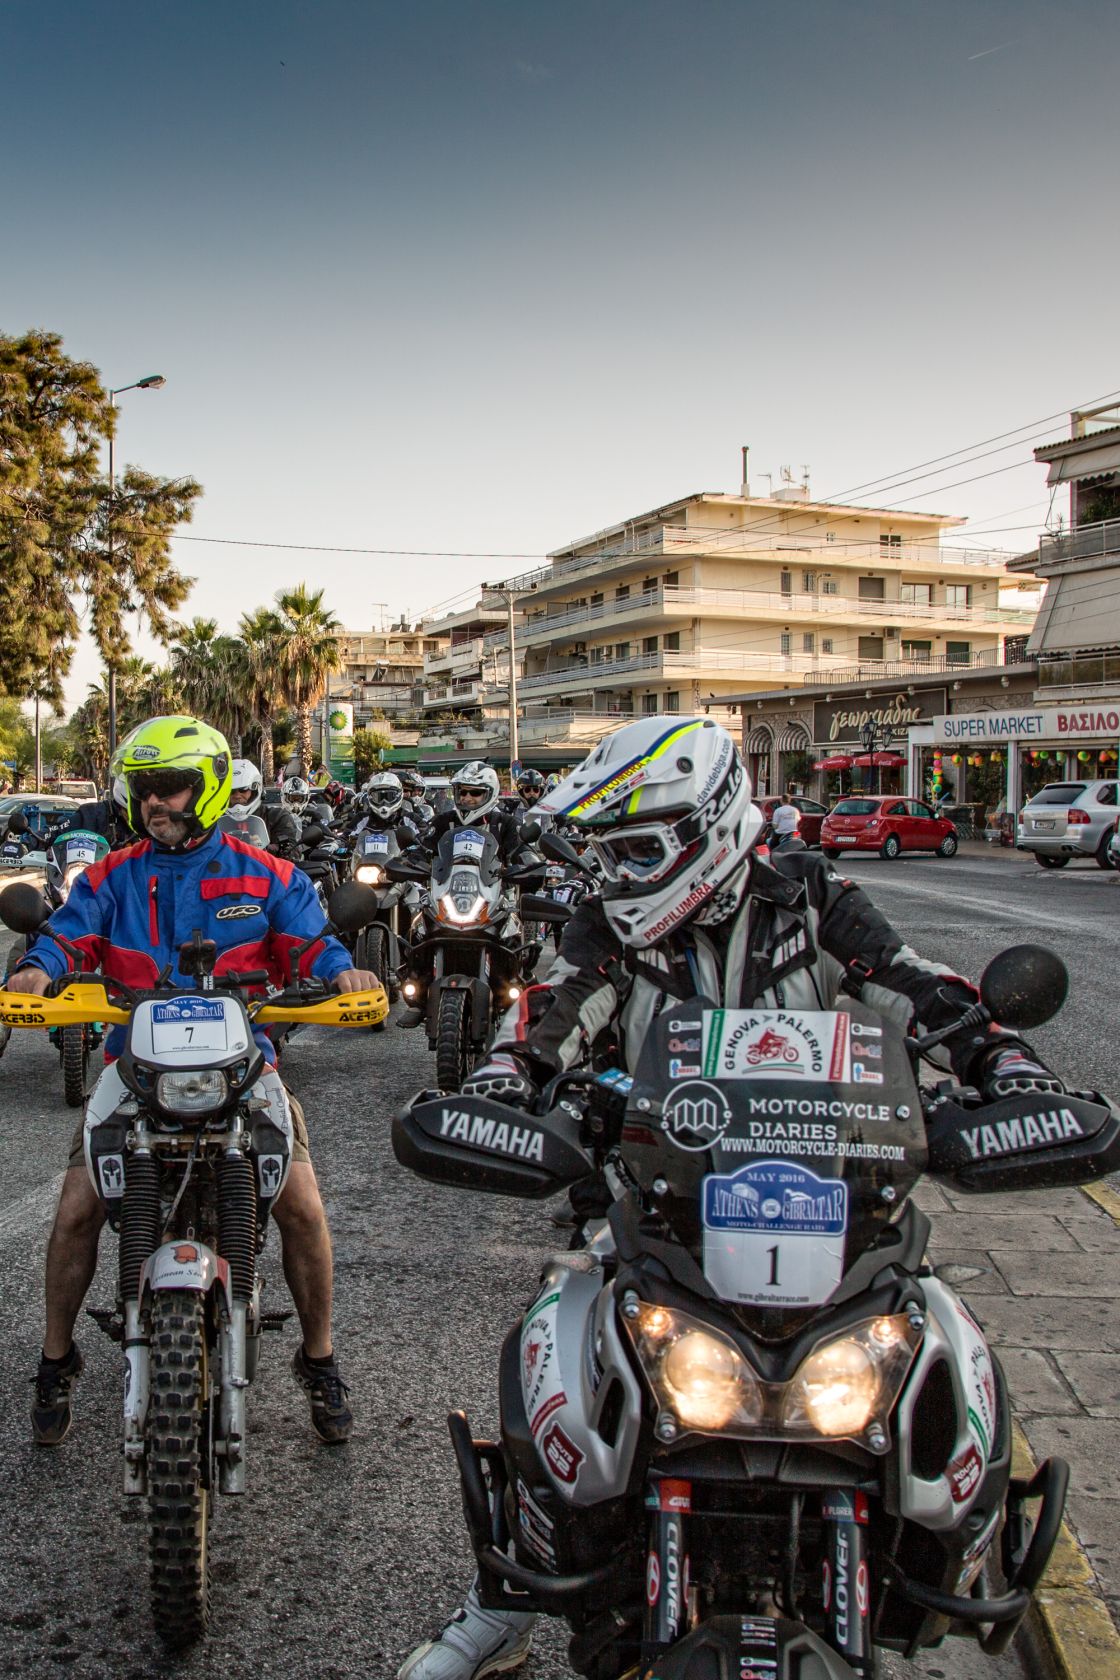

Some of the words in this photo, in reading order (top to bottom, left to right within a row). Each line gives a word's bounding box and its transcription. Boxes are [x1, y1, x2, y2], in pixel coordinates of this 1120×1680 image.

[944, 719, 986, 738] SUPER
[989, 715, 1044, 735] MARKET
[1057, 711, 1120, 732] ΒΑΣΙΛΟ
[696, 737, 732, 805] davidebiga.com
[76, 850, 86, 859] 45
[463, 843, 473, 851] 42
[216, 904, 262, 919] UFO
[184, 1026, 195, 1044] 7
[724, 1017, 760, 1071] GENOVA
[777, 1013, 823, 1073] PALERMO
[749, 1098, 891, 1121] MOTORCYCLE
[439, 1108, 545, 1162] YAMAHA
[749, 1121, 838, 1140] DIARIES
[959, 1108, 1084, 1159] YAMAHA
[720, 1137, 905, 1161] WWW.MOTORCYCLE-DIARIES.COM
[746, 1172, 776, 1182] MAY
[778, 1173, 806, 1184] 2016
[711, 1187, 759, 1219] ATHENS
[781, 1187, 843, 1222] GIBRALTAR
[765, 1244, 782, 1287] 1
[548, 1447, 571, 1477] 22
[552, 1436, 575, 1464] ROUTE
[953, 1456, 977, 1482] ROUTE
[958, 1464, 980, 1496] 22
